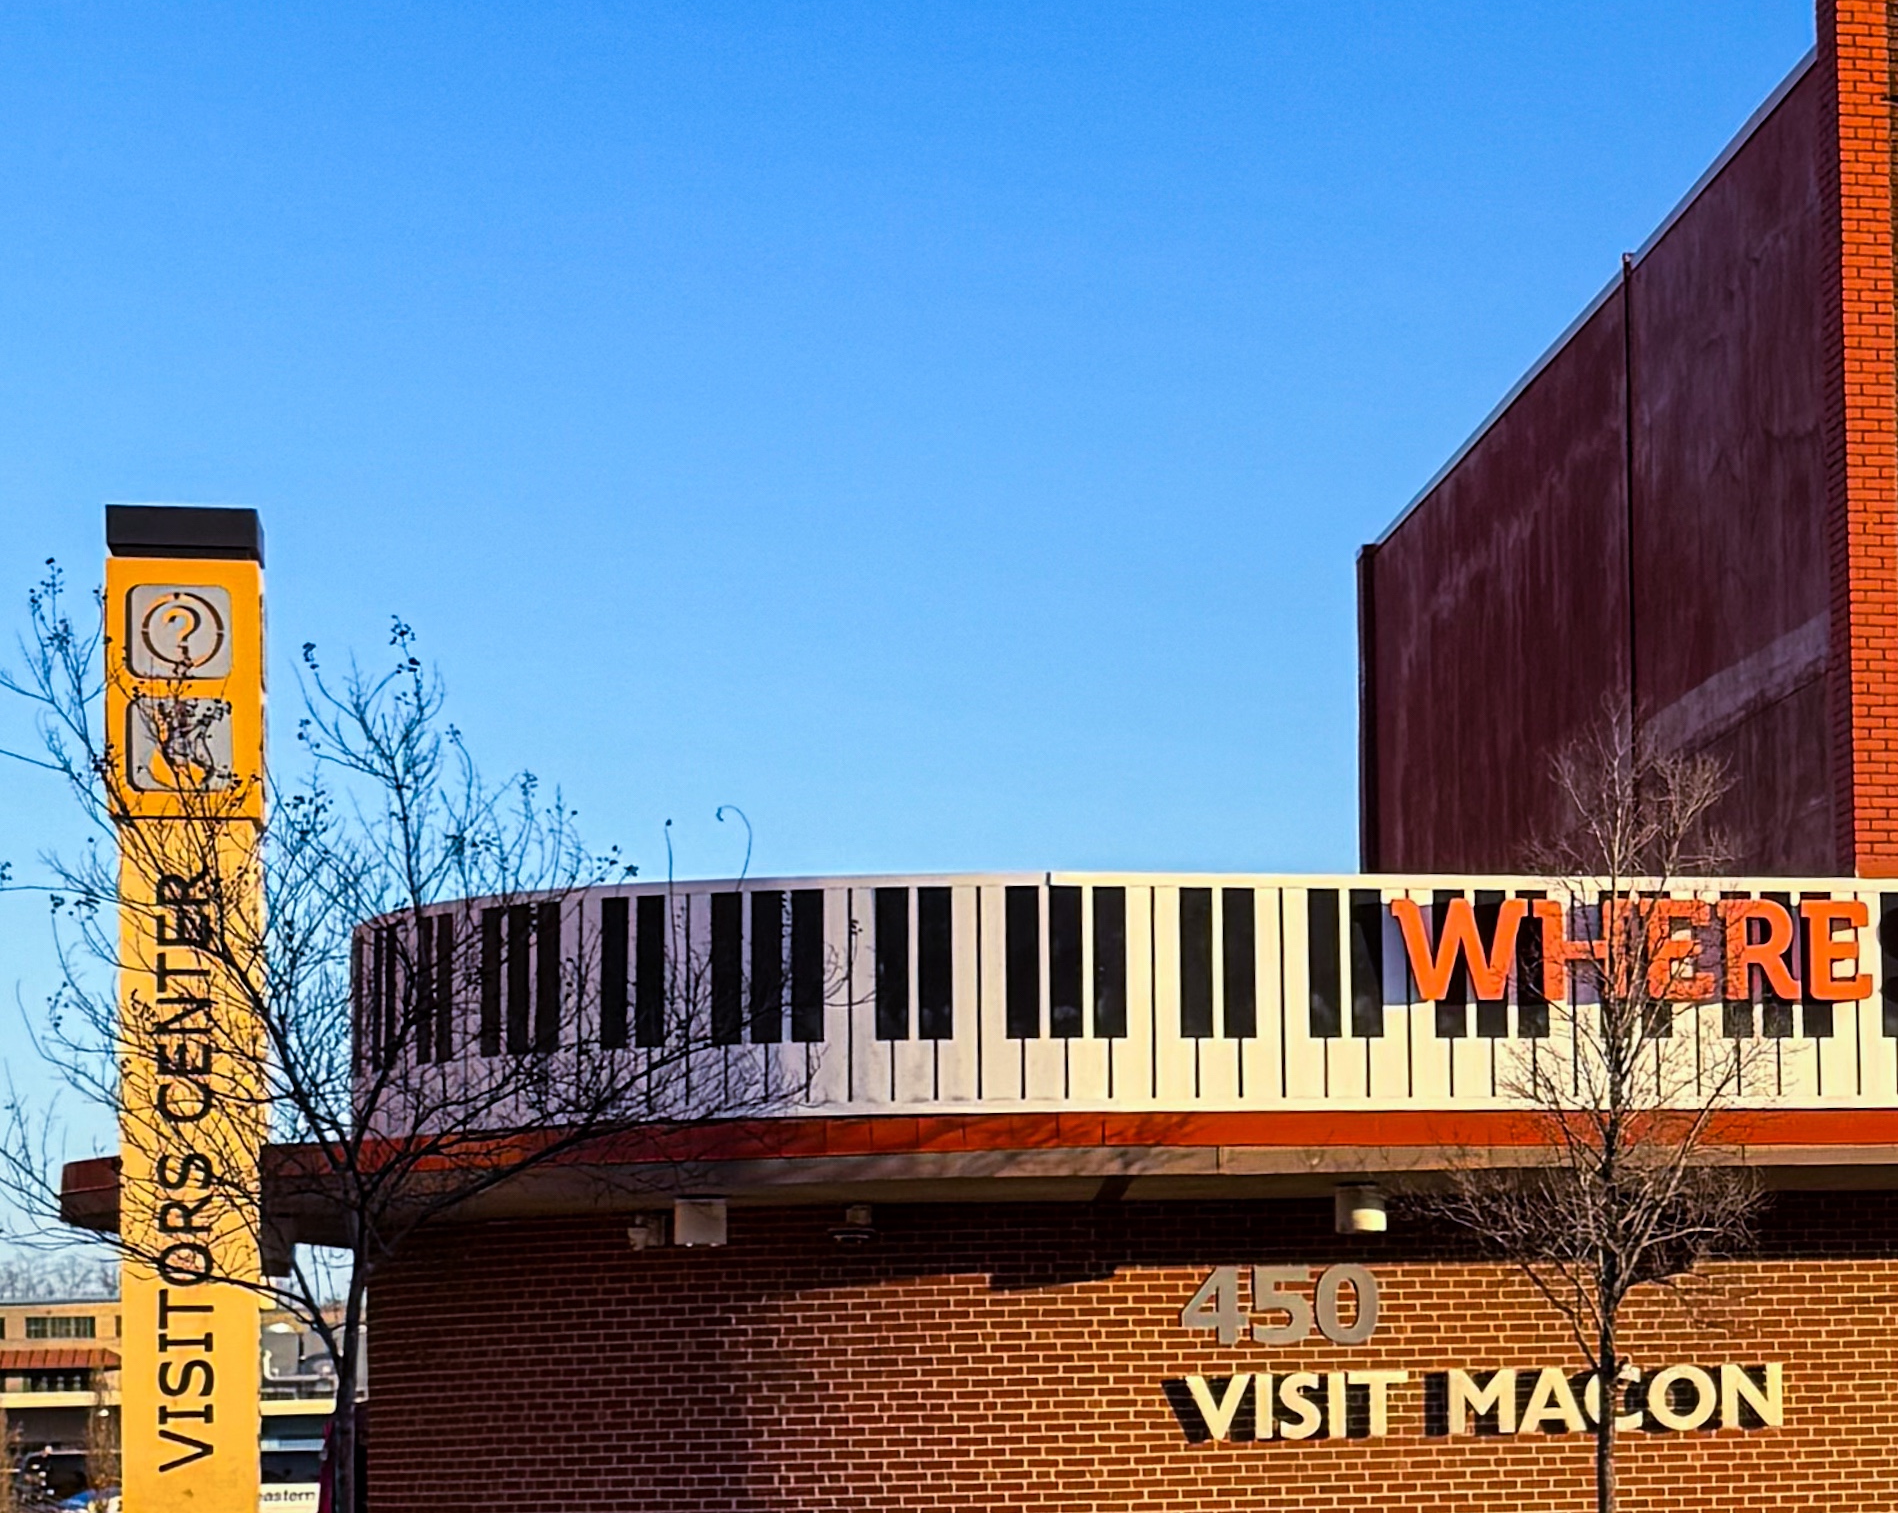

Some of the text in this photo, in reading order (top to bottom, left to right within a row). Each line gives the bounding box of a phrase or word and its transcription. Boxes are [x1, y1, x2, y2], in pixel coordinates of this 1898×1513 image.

[1390, 897, 1874, 1002] WHERE
[155, 871, 216, 1474] VISITORS CENTER
[1180, 1264, 1379, 1346] 450
[1184, 1361, 1784, 1441] VISIT MACON
[258, 1489, 316, 1502] astern
